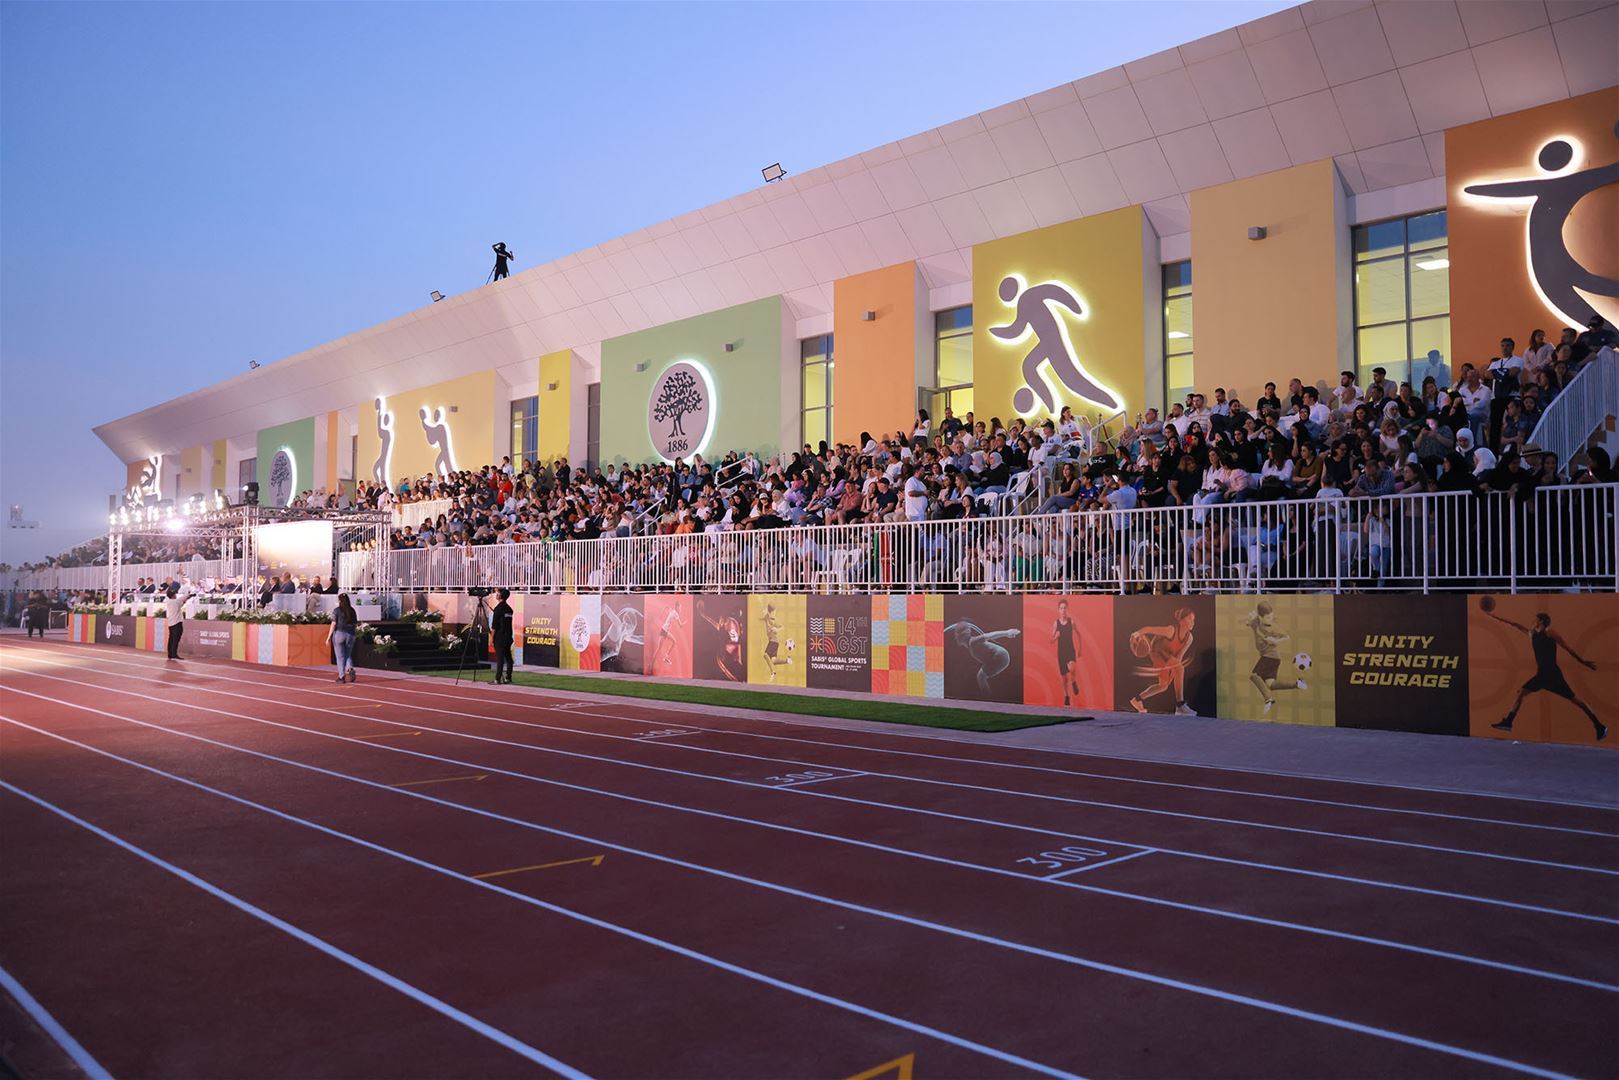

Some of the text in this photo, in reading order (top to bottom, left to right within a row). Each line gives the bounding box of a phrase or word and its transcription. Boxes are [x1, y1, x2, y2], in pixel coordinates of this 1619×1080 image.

[668, 439, 688, 452] 1886
[531, 617, 552, 625] UNITY
[525, 627, 559, 635] STRENGTH
[527, 637, 557, 645] COURAGE
[837, 636, 868, 654] GST
[1364, 635, 1434, 649] UNITY
[1343, 653, 1459, 669] STRENGTH
[1350, 672, 1452, 688] COURAGE
[764, 771, 833, 783] 300
[1016, 846, 1107, 869] 300
